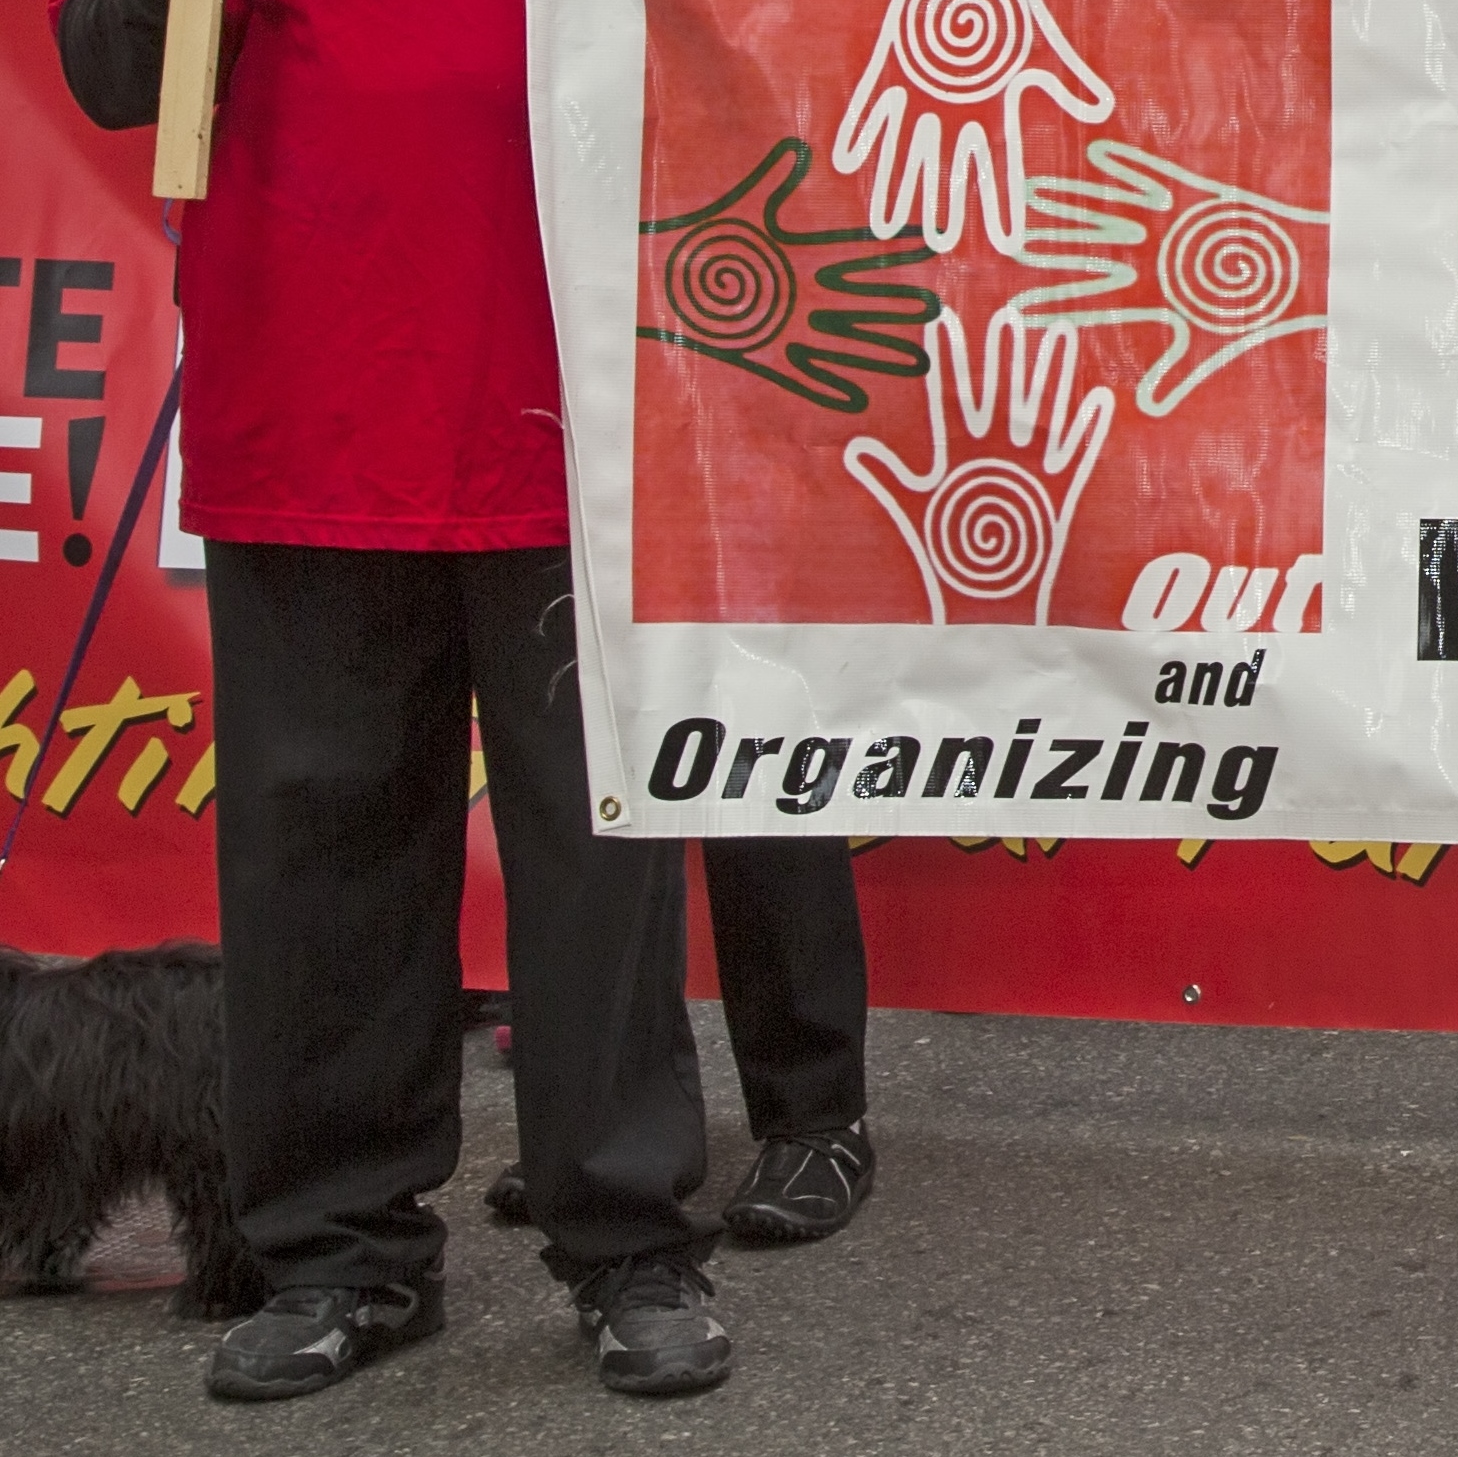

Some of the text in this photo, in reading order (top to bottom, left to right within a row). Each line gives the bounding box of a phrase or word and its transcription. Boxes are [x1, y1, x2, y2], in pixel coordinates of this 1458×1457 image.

[1121, 552, 1324, 632] Out
[1155, 648, 1266, 707] and
[648, 717, 1278, 820] Organizing
